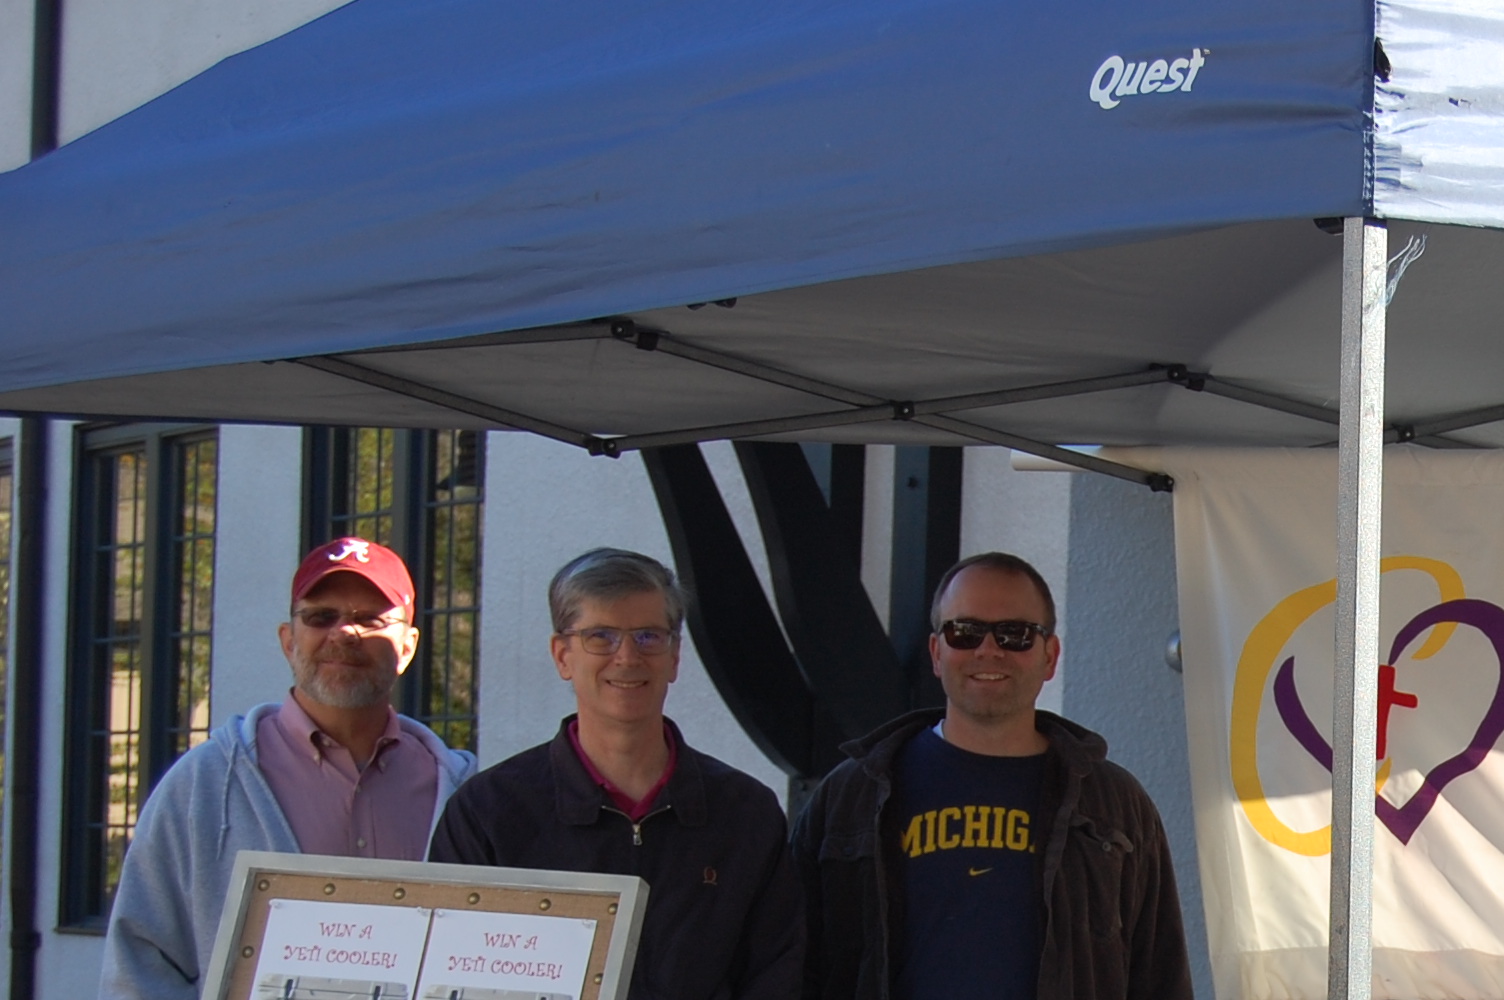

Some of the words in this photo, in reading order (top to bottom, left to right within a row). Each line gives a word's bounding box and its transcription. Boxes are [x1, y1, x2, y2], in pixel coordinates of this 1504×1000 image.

[1089, 48, 1205, 110] Quest
[319, 922, 356, 938] WIN
[359, 924, 373, 940] A
[484, 932, 521, 949] WIN
[524, 934, 539, 950] A
[284, 944, 322, 962] YETI
[326, 949, 397, 969] COOLER!
[448, 955, 486, 973] YETI
[490, 960, 562, 980] COOLER!
